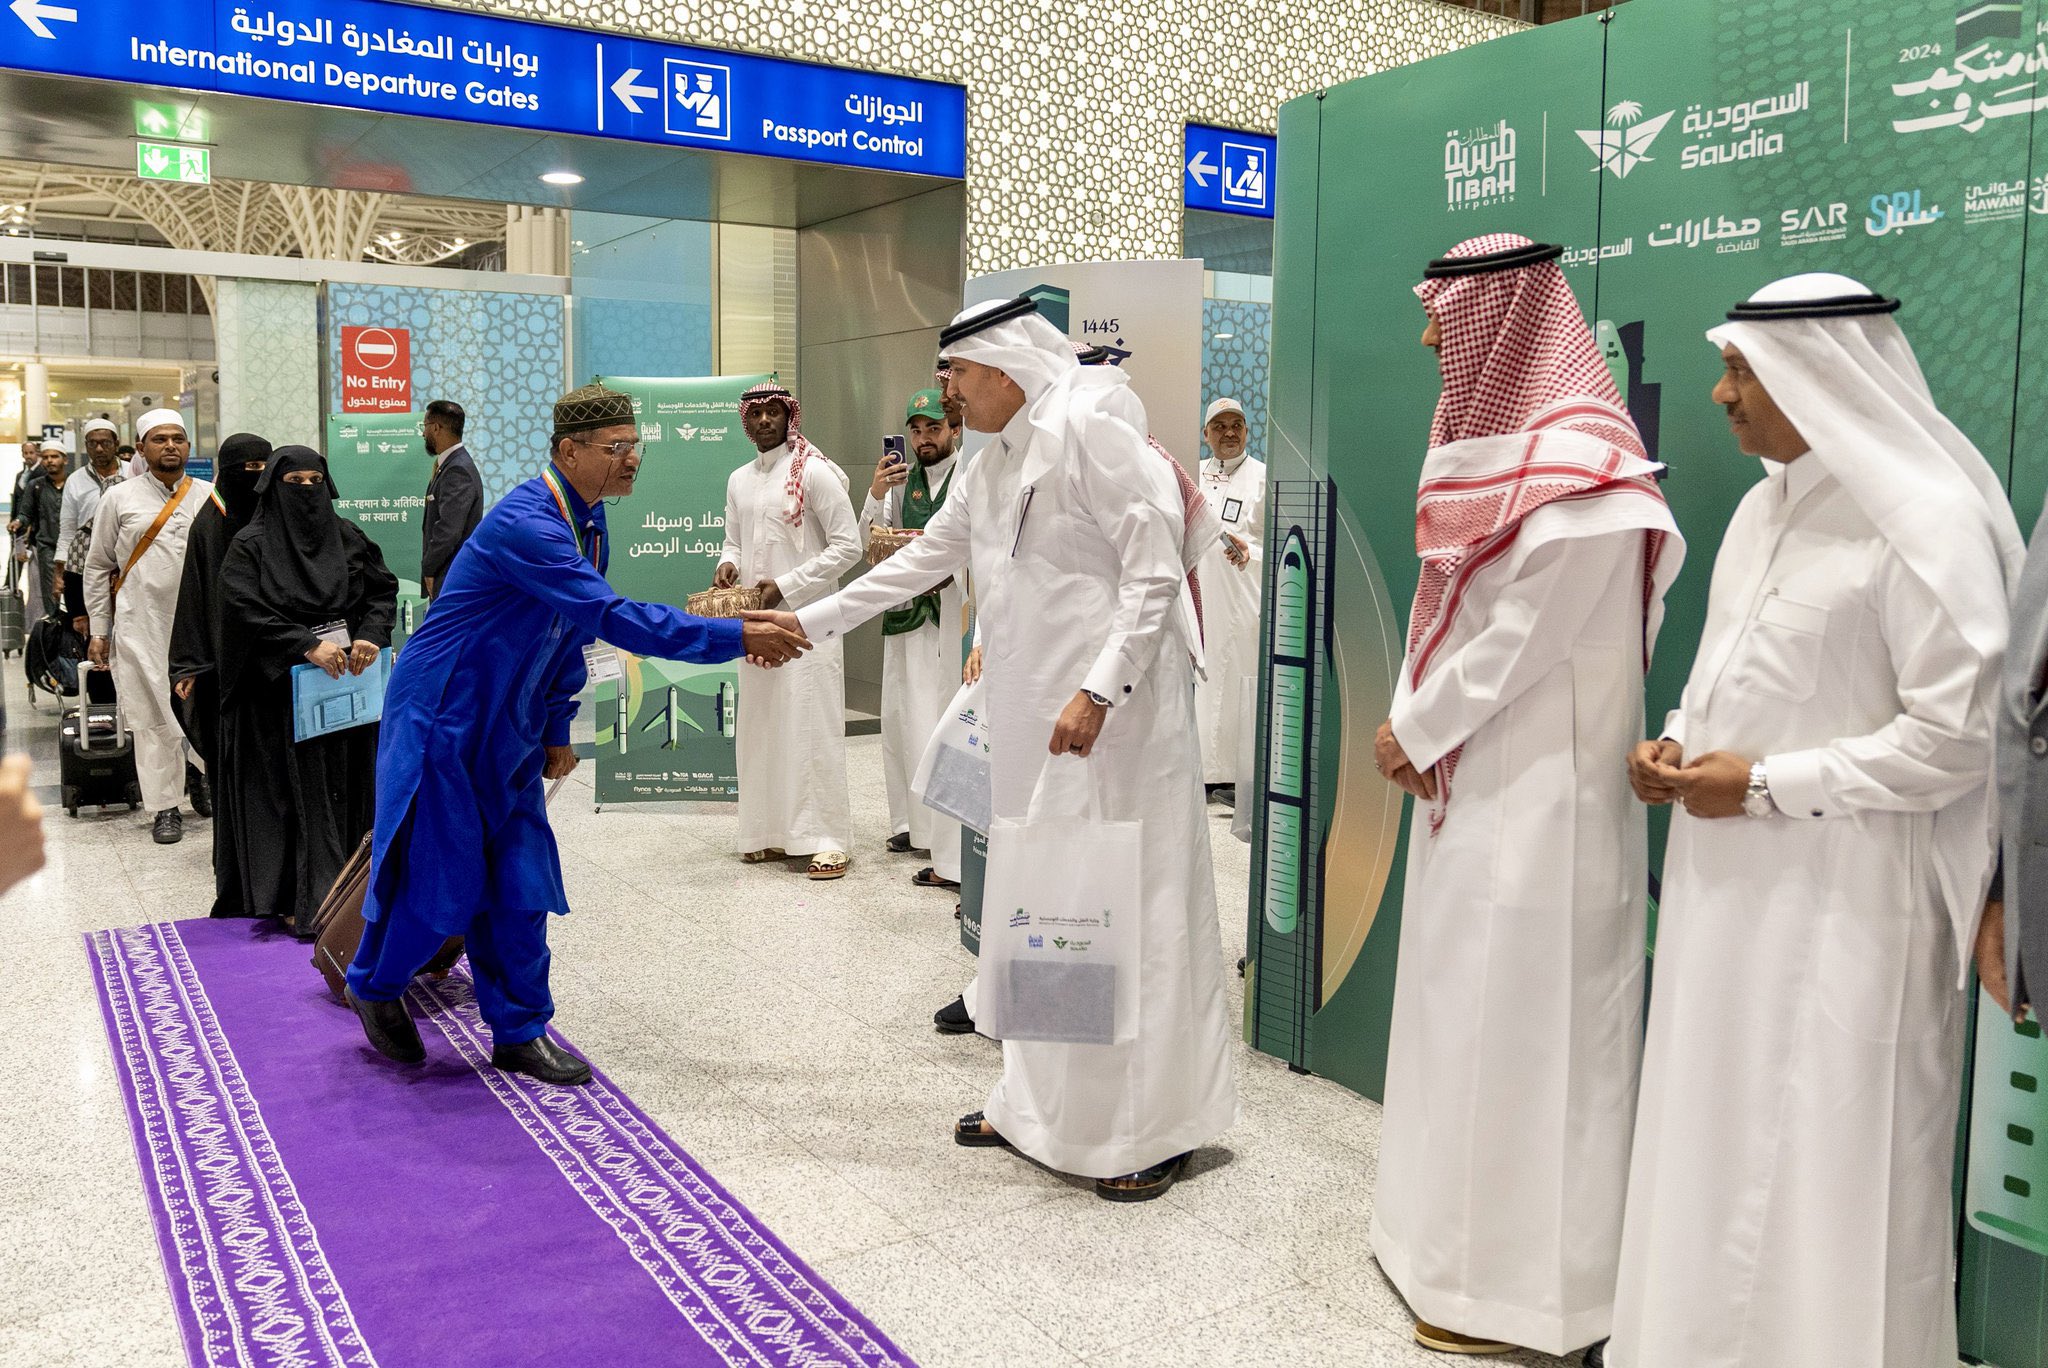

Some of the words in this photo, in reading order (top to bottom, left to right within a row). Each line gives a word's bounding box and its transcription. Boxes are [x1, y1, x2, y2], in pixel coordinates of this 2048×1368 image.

[231, 7, 332, 46] الدولية
[342, 22, 453, 59] المغادرة
[461, 40, 539, 78] بوابات
[1898, 42, 1942, 63] 2024
[131, 36, 315, 83] International
[325, 63, 457, 101] Departure
[465, 81, 539, 112] Gates
[845, 94, 923, 126] الجوازات
[1681, 81, 1809, 140] السعودية
[762, 119, 848, 148] Passport
[852, 130, 923, 157] Control
[1965, 180, 2025, 200] موانئ
[1447, 195, 1515, 212] Airports
[1965, 193, 2025, 213] MAWANI
[1781, 202, 1848, 232] SAR
[1648, 214, 1761, 248] مطارات
[1561, 237, 1632, 267] السعودية
[1716, 239, 1759, 254] القابضة
[1082, 318, 1119, 334] 1445
[346, 375, 367, 388] No
[371, 376, 406, 392] Entry
[347, 397, 377, 408] الدخول
[379, 398, 407, 409] ممنوع
[43, 428, 63, 441] 15
[337, 499, 379, 510] अर-रहमान
[381, 497, 390, 509] के
[359, 512, 371, 522] का
[373, 512, 399, 522] स्वागत
[401, 510, 408, 522] है
[642, 511, 693, 532] وسهلا
[698, 506, 727, 528] هلا
[629, 537, 679, 558] الرحمن
